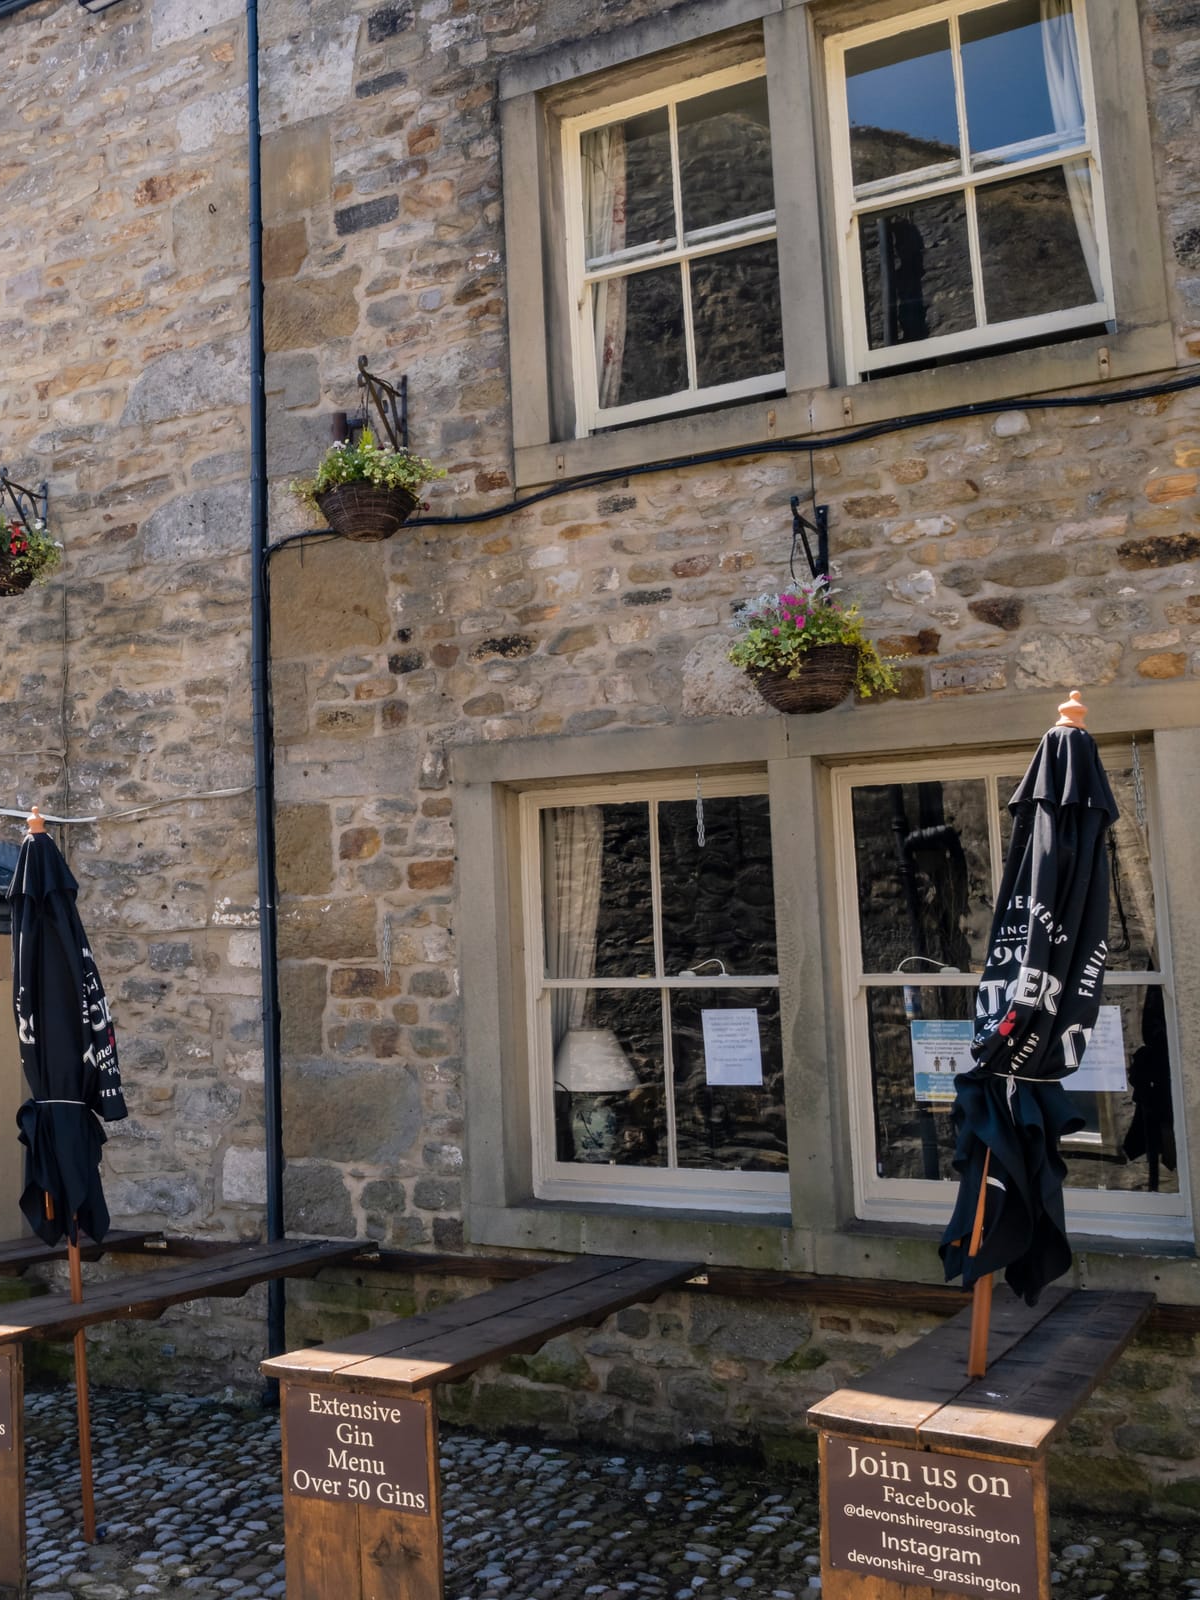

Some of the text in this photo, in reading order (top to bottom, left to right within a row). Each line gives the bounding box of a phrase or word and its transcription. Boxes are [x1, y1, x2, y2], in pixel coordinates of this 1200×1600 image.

[1078, 940, 1108, 997] FAMILY
[308, 1392, 401, 1424] Extensive
[336, 1423, 374, 1447] Gin
[327, 1447, 386, 1476] Menu
[847, 1446, 1012, 1498] Join us on
[293, 1469, 425, 1509] Over 50 Gins
[882, 1485, 977, 1517] Facebook
[843, 1503, 1021, 1545] @devonshiregrassington
[881, 1531, 982, 1566] Instagram
[847, 1549, 1021, 1594] devonshire_grassington
